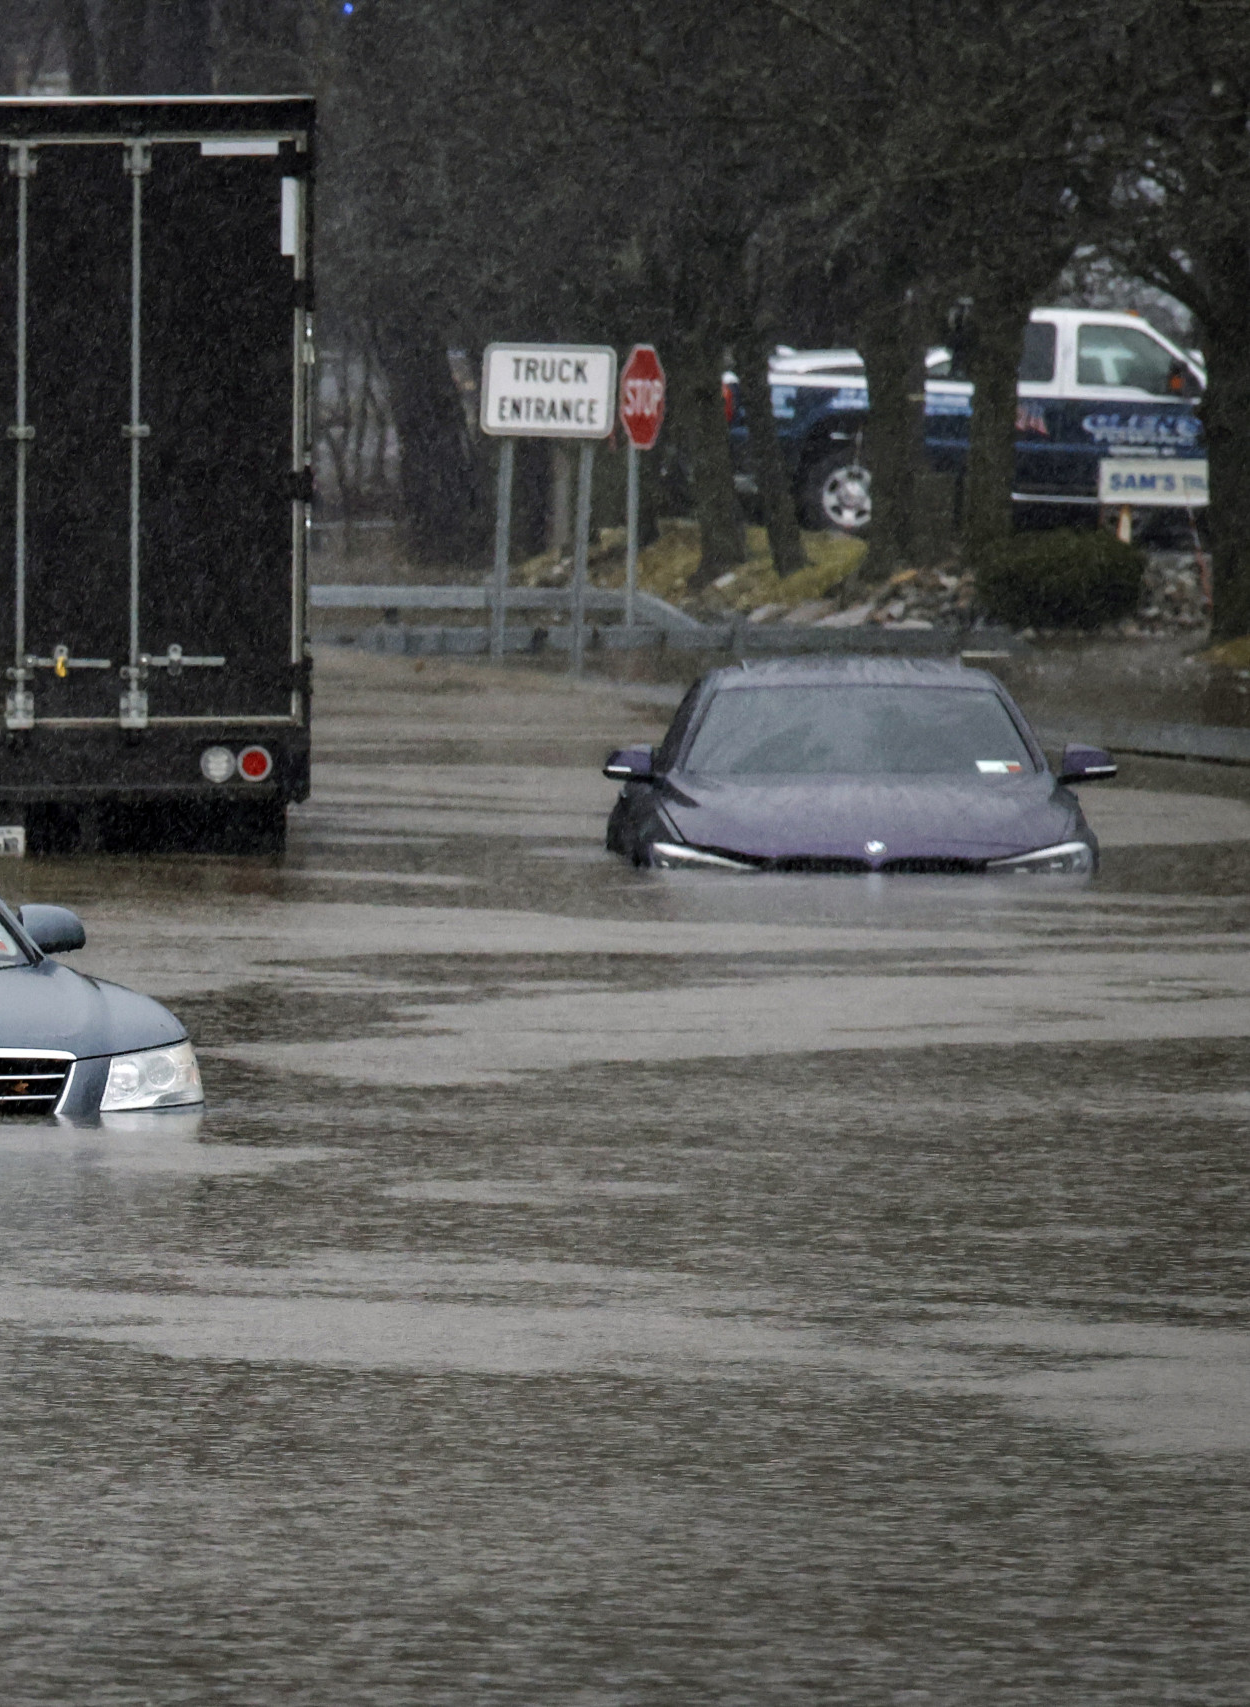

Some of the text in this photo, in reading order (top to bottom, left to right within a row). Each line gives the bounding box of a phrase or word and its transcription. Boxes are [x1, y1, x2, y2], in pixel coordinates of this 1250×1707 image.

[512, 357, 588, 384] TRUCK
[498, 395, 598, 425] ENTRANCE
[625, 378, 664, 417] STOP
[1110, 472, 1176, 491] SAM'S
